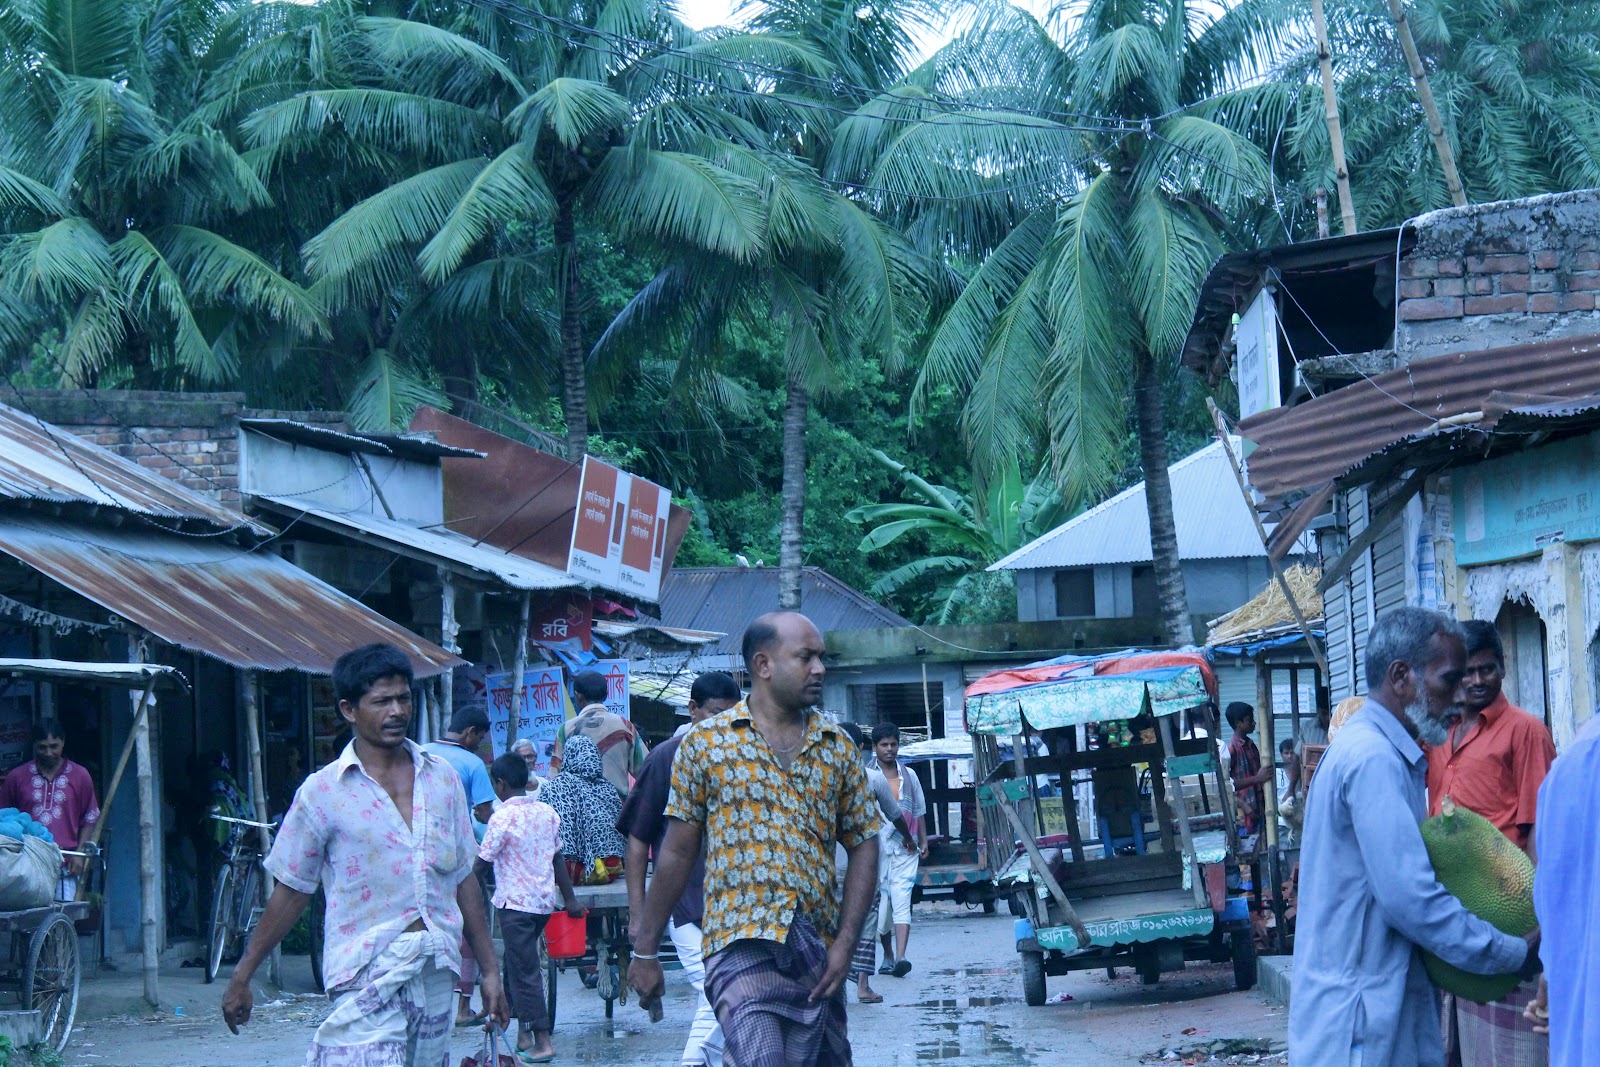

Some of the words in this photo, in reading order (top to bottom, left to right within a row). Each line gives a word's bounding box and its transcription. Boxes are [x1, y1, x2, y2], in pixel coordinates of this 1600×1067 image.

[542, 618, 568, 638] রবি
[605, 702, 626, 714] সন্টার
[494, 716, 531, 733] মোইল
[534, 712, 562, 728] সেন্টার
